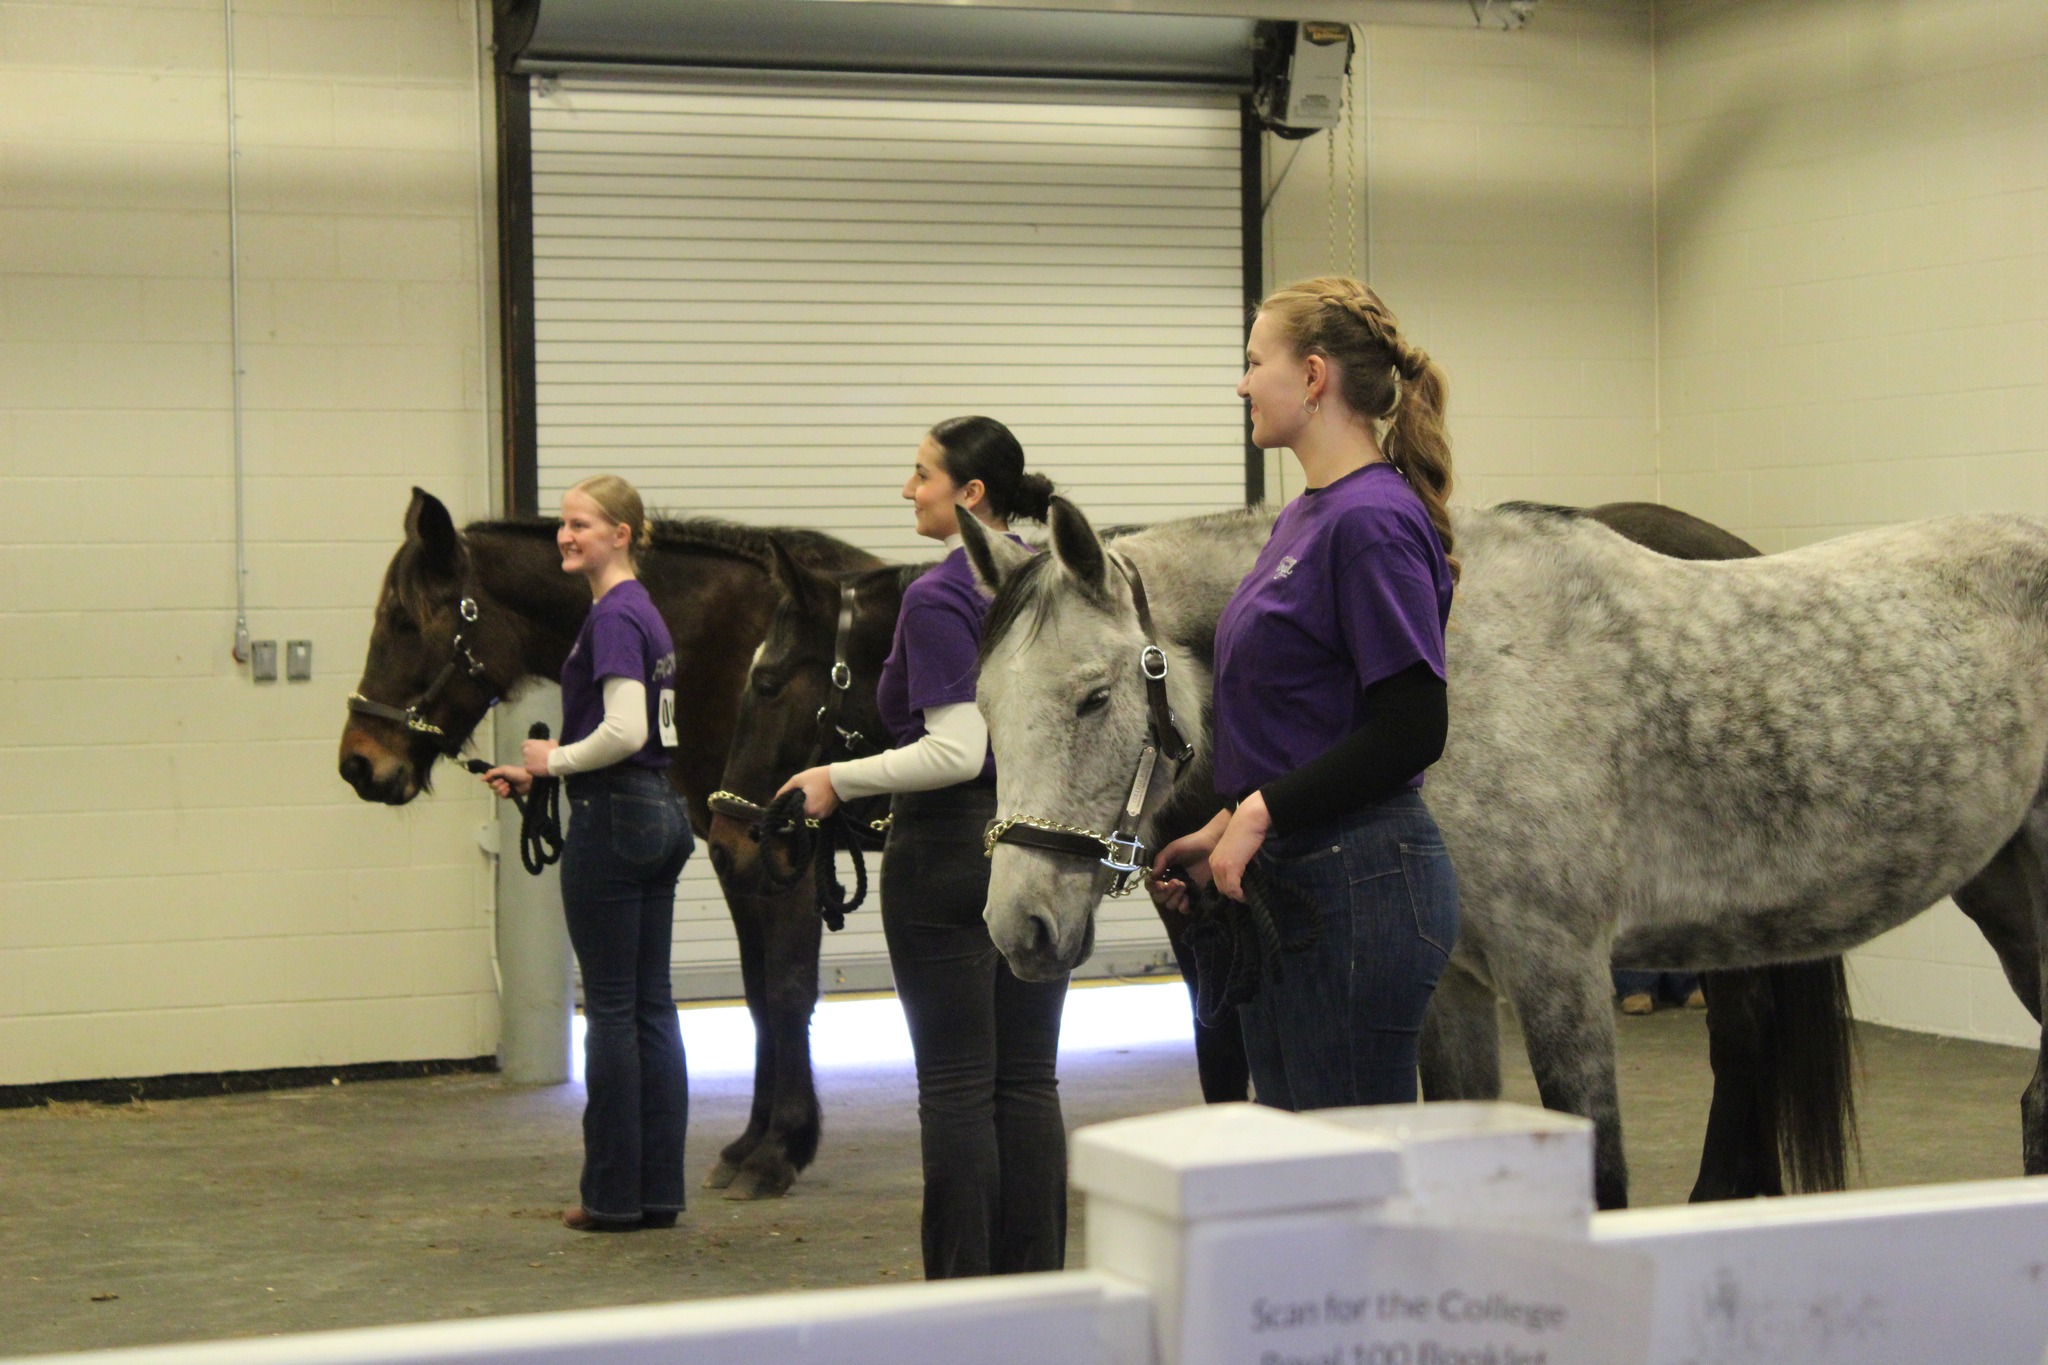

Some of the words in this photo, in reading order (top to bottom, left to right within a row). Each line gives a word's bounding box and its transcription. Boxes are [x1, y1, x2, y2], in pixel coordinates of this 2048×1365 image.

[1251, 1297, 1319, 1332] Scan
[1325, 1290, 1368, 1323] for
[1376, 1288, 1430, 1321] the
[1437, 1288, 1568, 1334] College
